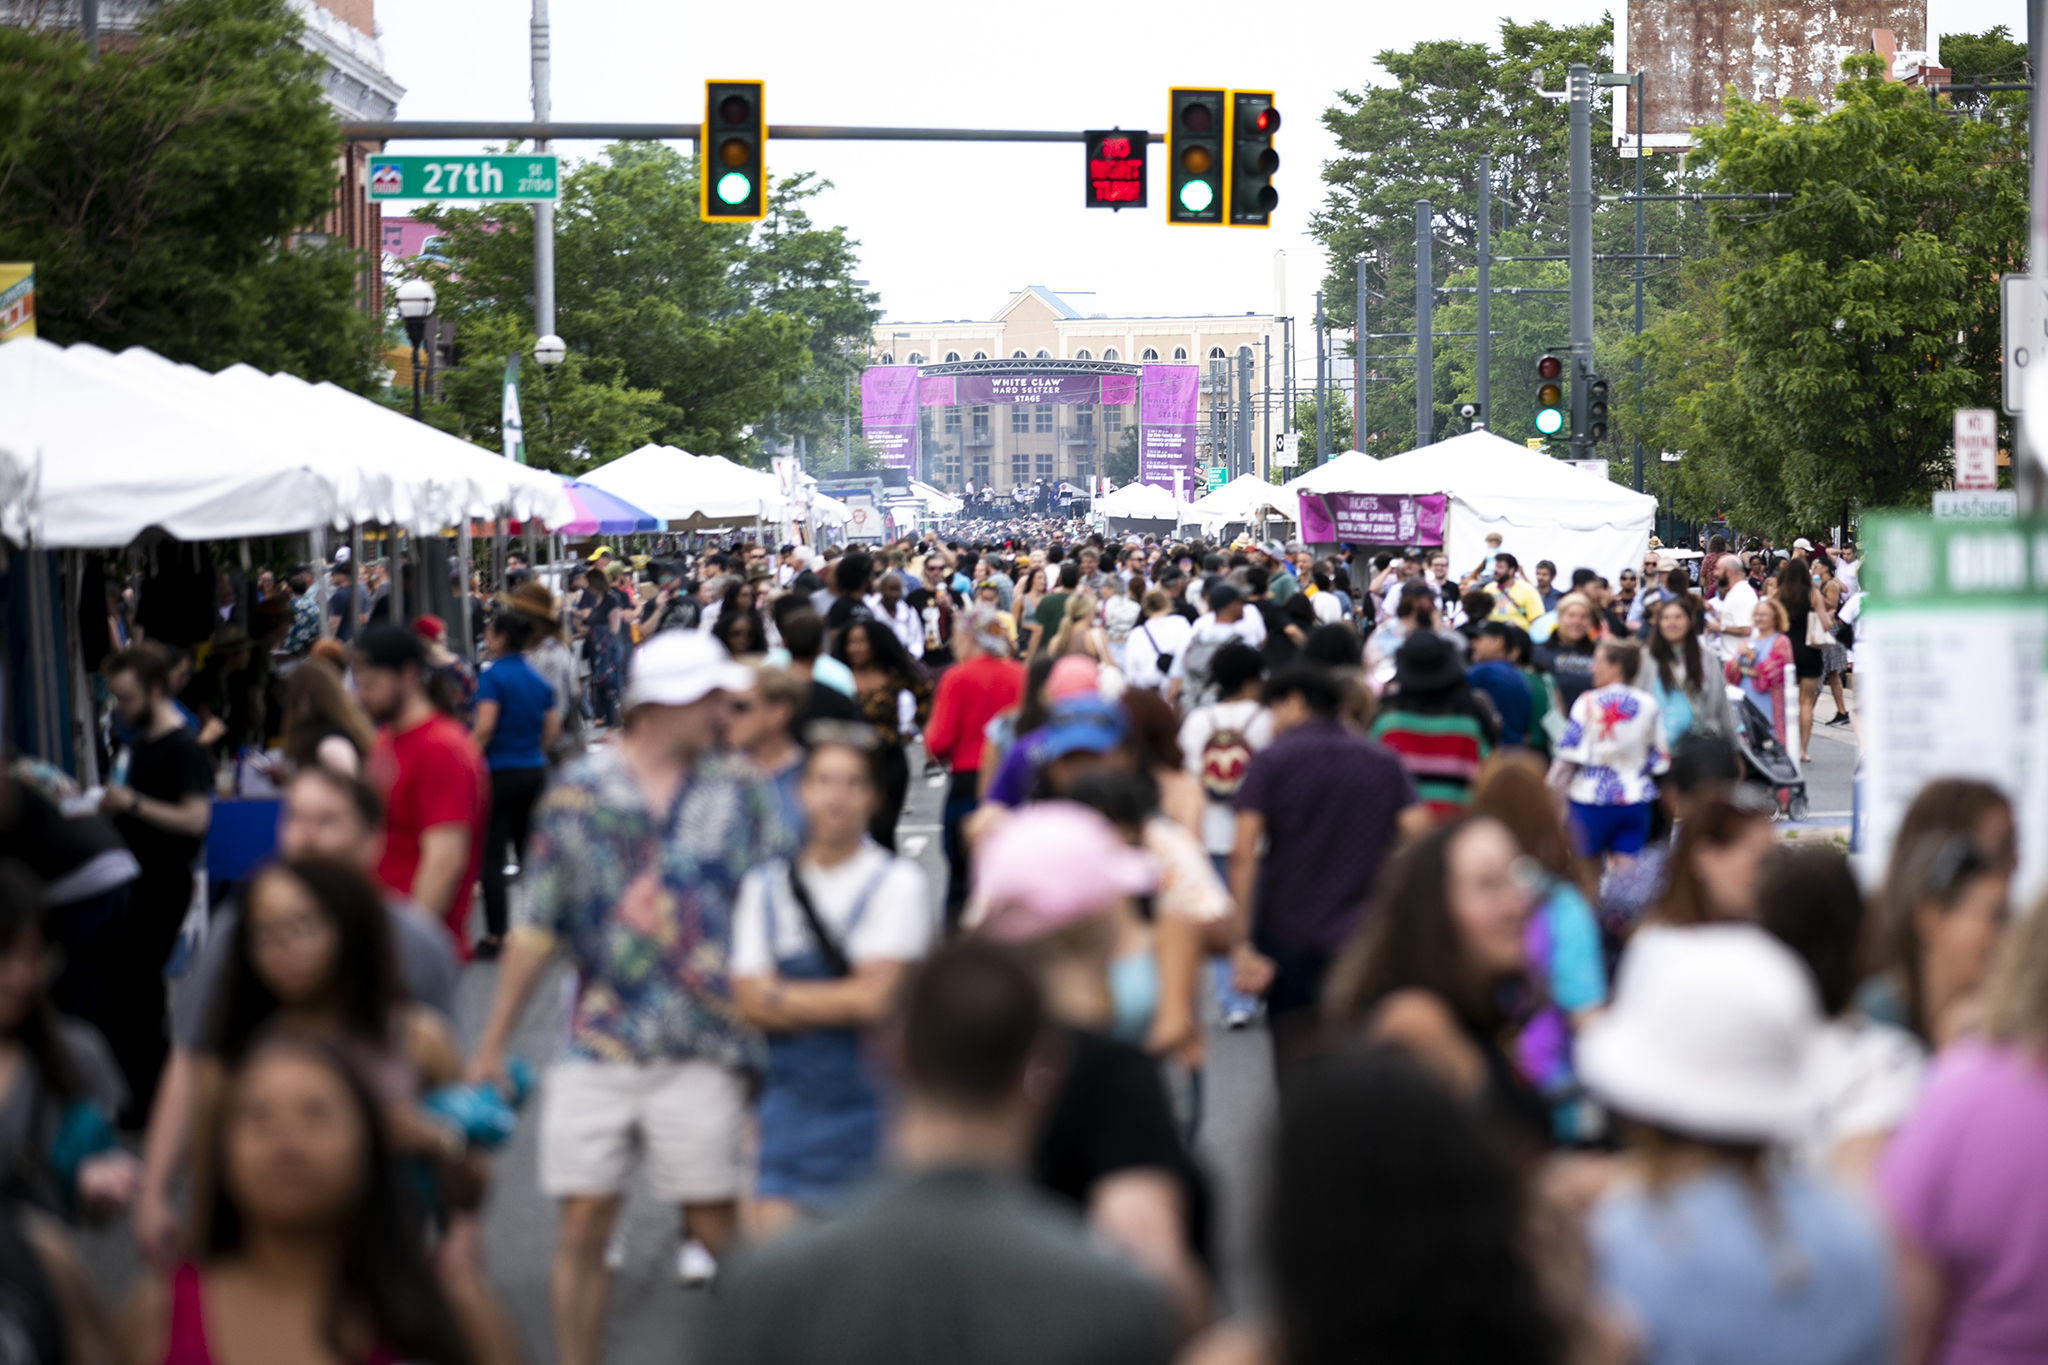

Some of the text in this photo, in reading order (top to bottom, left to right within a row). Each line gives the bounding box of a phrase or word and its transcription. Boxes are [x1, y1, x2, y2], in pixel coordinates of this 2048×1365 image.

[423, 161, 503, 194] 27th
[517, 178, 554, 193] 2700
[991, 378, 1062, 387] WHITE CLAW
[1014, 395, 1041, 403] STAGE
[1157, 411, 1182, 419] STAGE
[1967, 418, 1984, 431] NO
[1940, 500, 2011, 517] EASTSIDE
